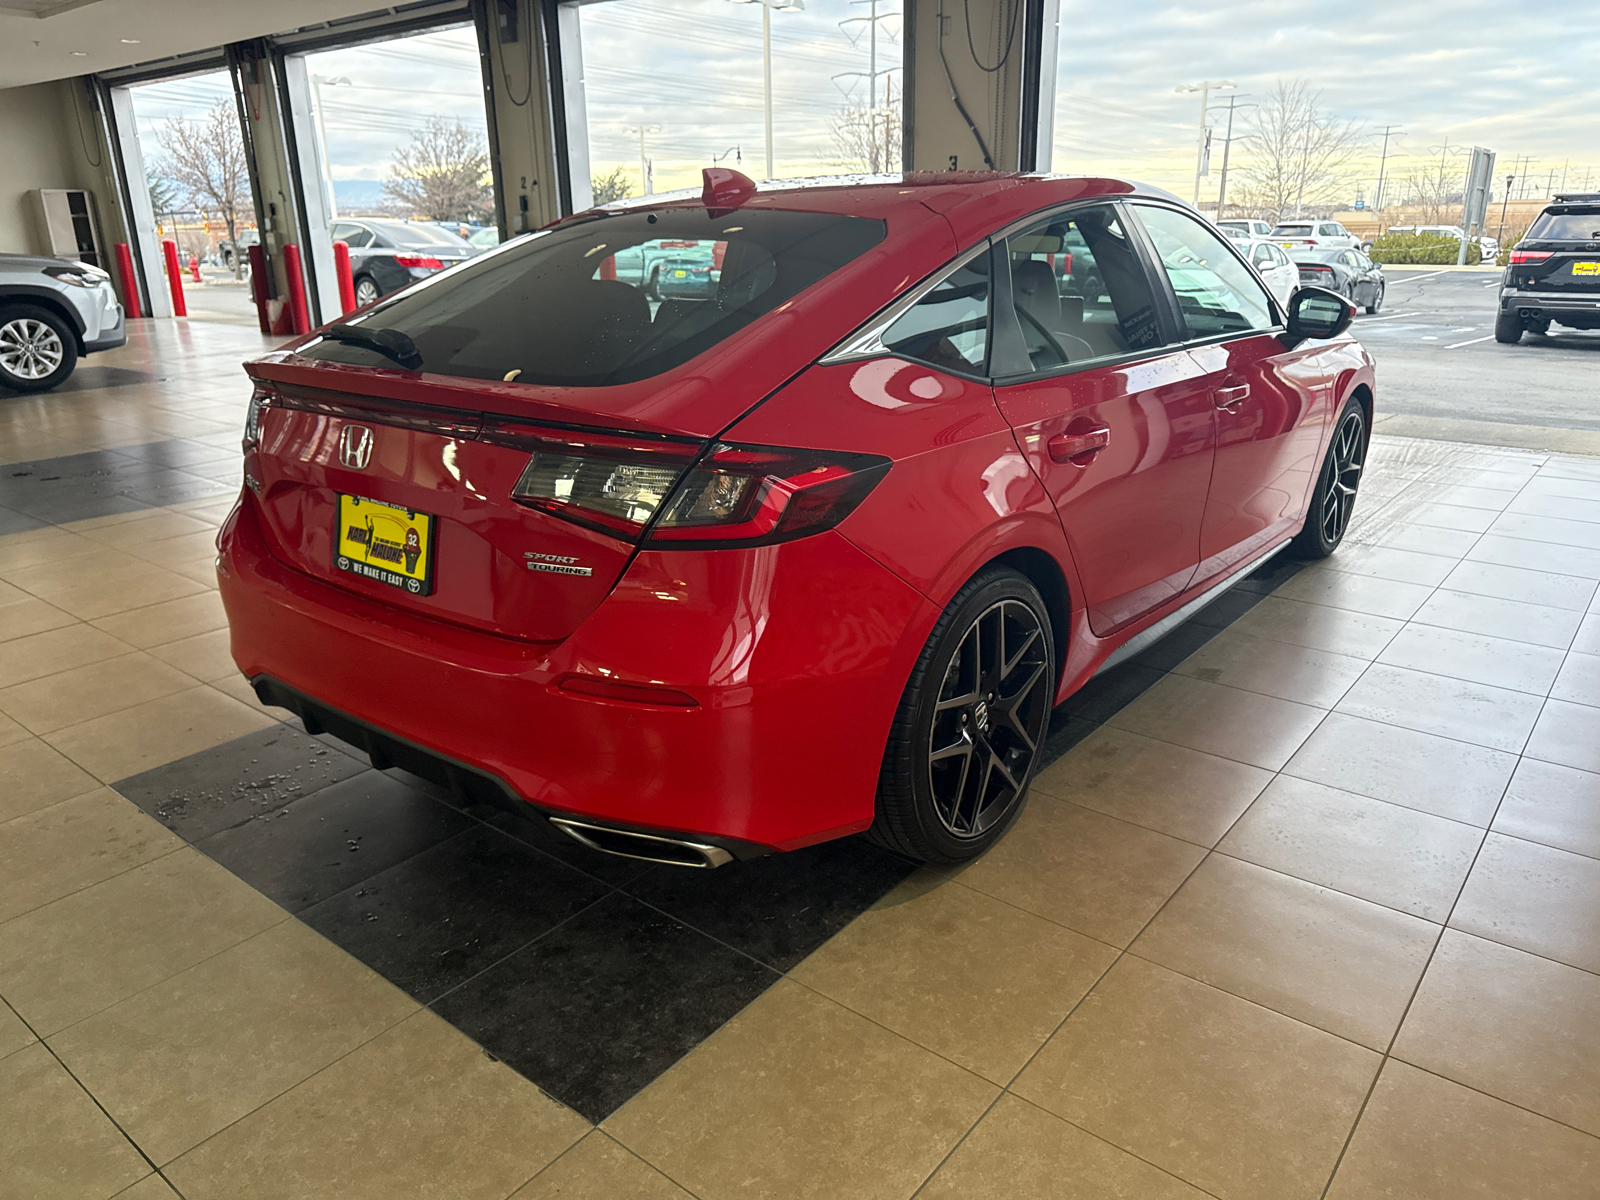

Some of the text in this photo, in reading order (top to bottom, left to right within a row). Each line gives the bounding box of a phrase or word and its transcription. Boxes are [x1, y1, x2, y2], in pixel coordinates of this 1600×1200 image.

[949, 155, 958, 171] 3
[520, 176, 527, 190] 2
[407, 533, 417, 547] 32
[369, 541, 403, 565] MALONE
[523, 551, 580, 564] SPORT
[352, 562, 404, 587] WE MAKE IT EASY
[531, 563, 587, 575] TOURING
